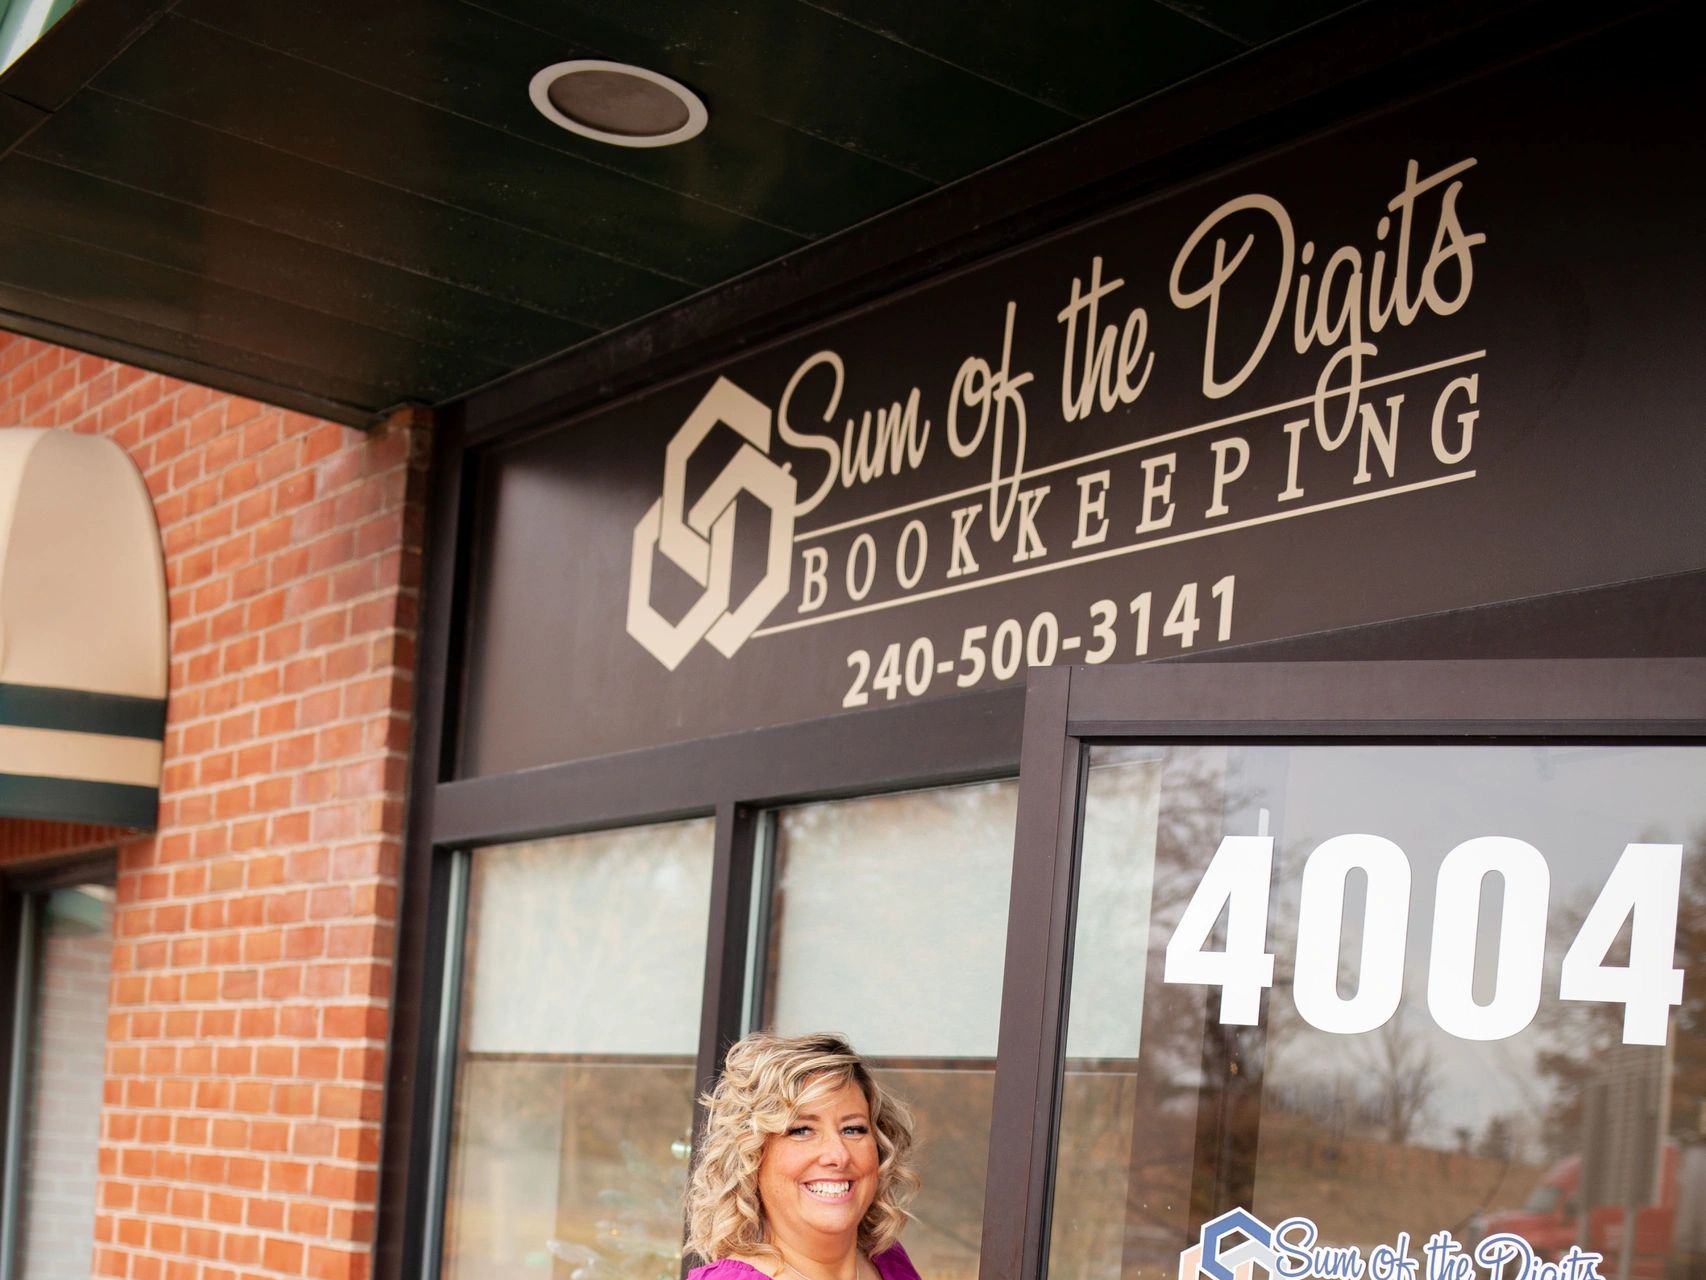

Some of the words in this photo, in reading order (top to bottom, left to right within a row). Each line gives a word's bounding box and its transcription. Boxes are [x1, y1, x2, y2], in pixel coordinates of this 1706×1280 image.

[777, 350, 931, 516] Sum
[947, 301, 1034, 543] of
[1057, 255, 1155, 422] the
[1169, 157, 1487, 452] Digits
[798, 373, 1480, 614] BOOKKEEPING
[842, 574, 1237, 709] 240-500-3141
[1164, 833, 1685, 1046] 4004
[1274, 1219, 1363, 1279] Sum
